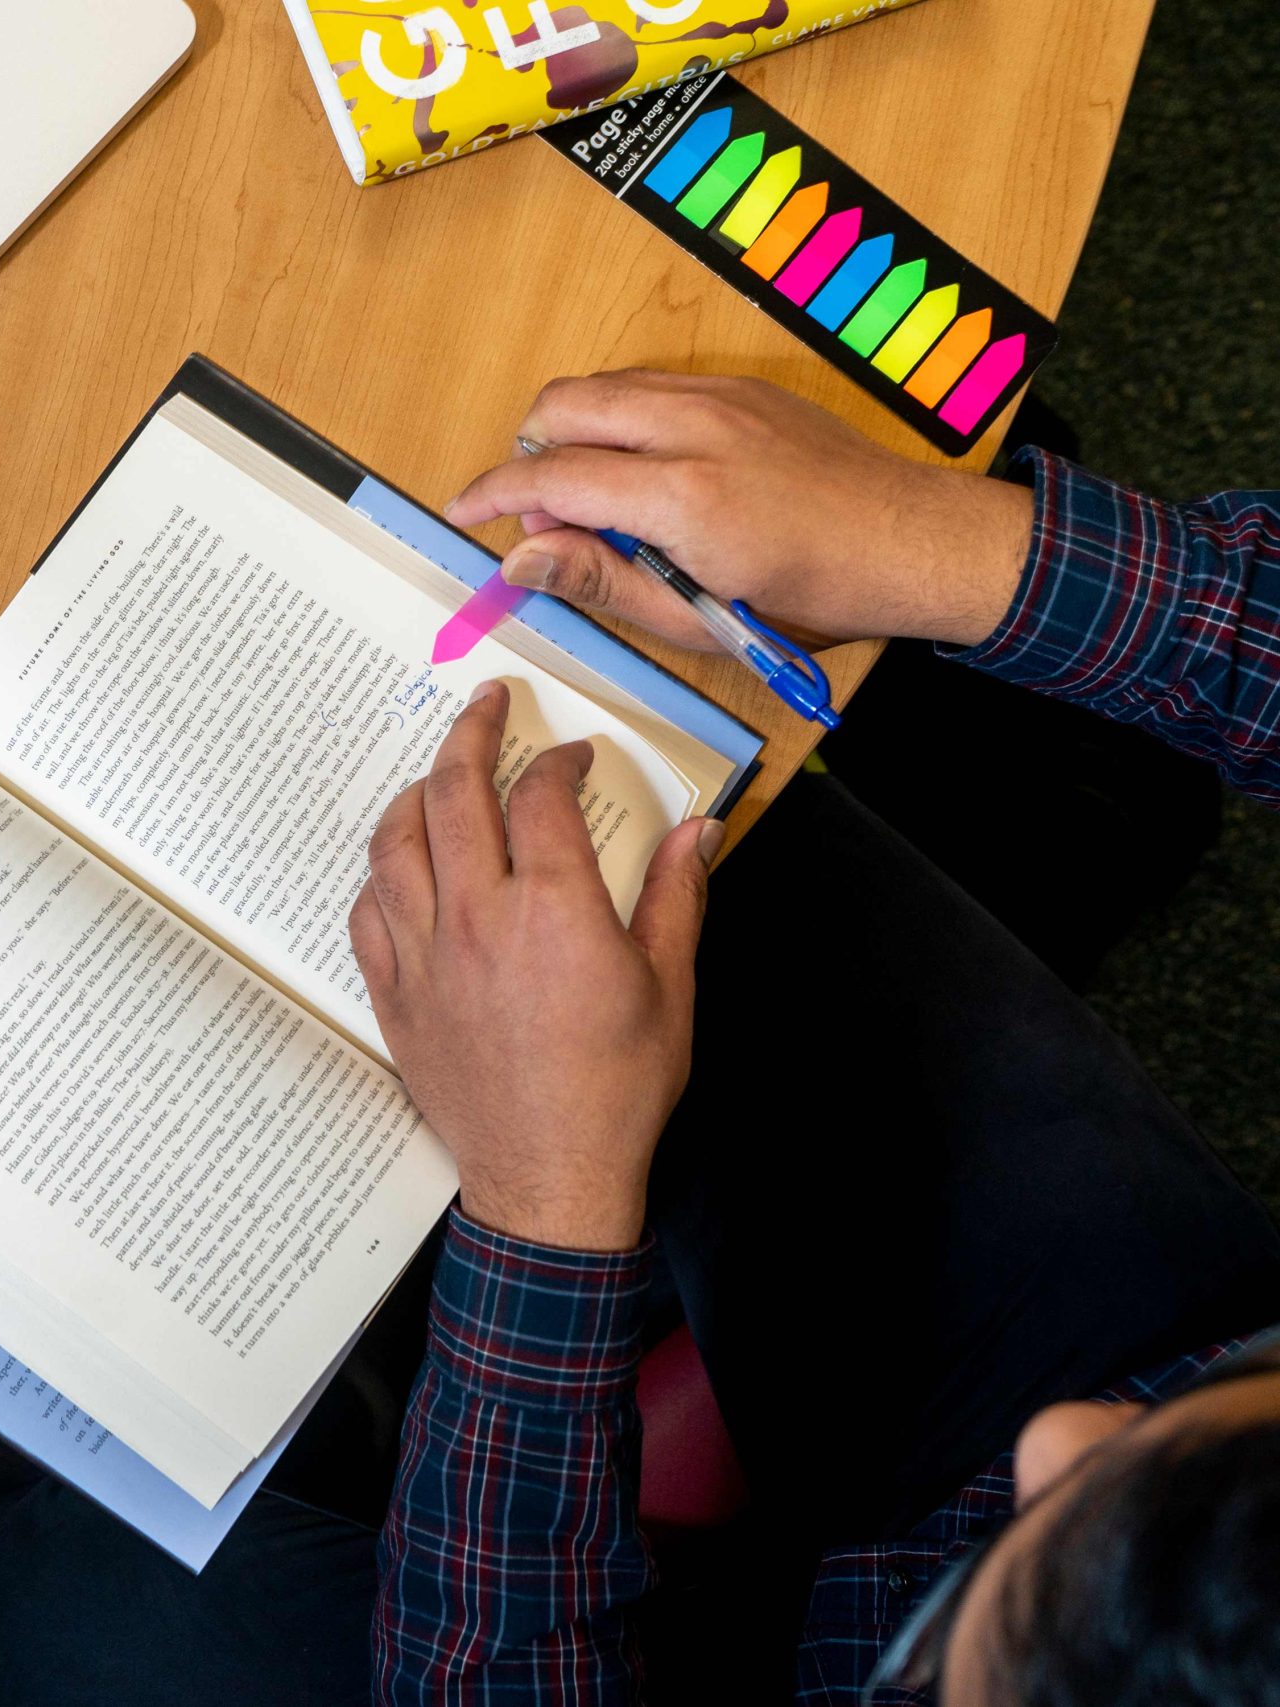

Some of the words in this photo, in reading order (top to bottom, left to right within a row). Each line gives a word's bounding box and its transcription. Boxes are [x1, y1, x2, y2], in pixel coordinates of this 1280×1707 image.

[771, 13, 845, 45] CLAIRE
[570, 107, 627, 163] Page
[595, 153, 617, 177] 200
[617, 125, 645, 156] sticky
[642, 99, 666, 126] page
[614, 152, 641, 178] book
[645, 114, 675, 143] home
[681, 76, 706, 103] office
[393, 136, 495, 177] GOLD
[18, 647, 44, 680] FUTURE
[43, 620, 63, 645] HOME
[63, 606, 72, 618] OF
[72, 589, 86, 604] THE
[86, 558, 109, 587] LIVING
[108, 539, 124, 556] GOD
[18, 742, 34, 761] rush
[31, 728, 40, 742] of
[37, 717, 51, 732] air.
[46, 697, 63, 715] The
[58, 673, 81, 698] lights
[78, 661, 90, 674] on
[86, 646, 100, 661] the
[97, 619, 120, 647] towers
[117, 595, 137, 622] glitter
[133, 587, 144, 597] in
[141, 573, 154, 588] the
[151, 554, 168, 574] clear
[165, 533, 185, 556] night.
[179, 515, 197, 531] The
[401, 662, 433, 707] Ecological
[409, 683, 439, 716] change
[288, 883, 297, 891] I
[294, 870, 308, 886] say.
[315, 838, 329, 853] the
[249, 1095, 269, 1119] glass.
[218, 1115, 254, 1154] breaking
[213, 1148, 224, 1163] of
[193, 1160, 216, 1190] sound
[180, 1188, 195, 1204] the
[161, 1201, 184, 1230] shield
[153, 1228, 164, 1239] to
[365, 1238, 380, 1254] 164
[128, 1236, 157, 1271] devised
[59, 1417, 69, 1431] of
[66, 1405, 78, 1420] the
[75, 1430, 86, 1442] on
